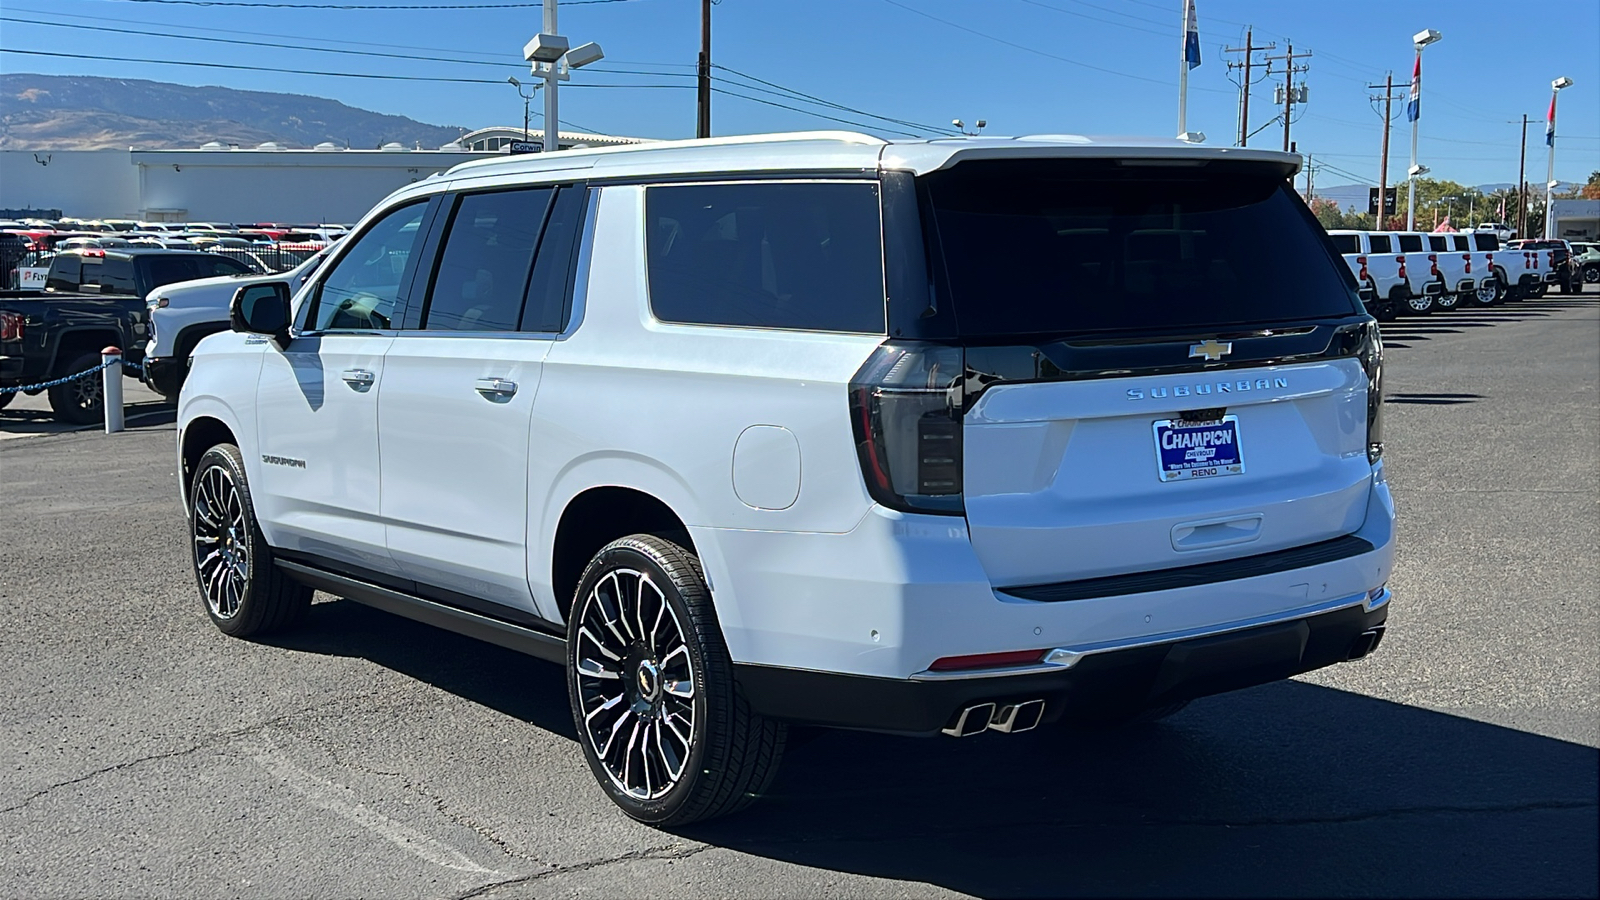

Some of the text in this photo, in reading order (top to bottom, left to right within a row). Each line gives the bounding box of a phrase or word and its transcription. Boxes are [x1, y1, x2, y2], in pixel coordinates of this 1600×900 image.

[513, 143, 541, 151] Corwin
[1126, 377, 1288, 400] SUBURBAN
[1162, 429, 1233, 450] CHAMPION
[1186, 449, 1215, 457] CHEVROLET
[261, 454, 307, 469] SUBURBAN
[1191, 467, 1218, 477] RENO
